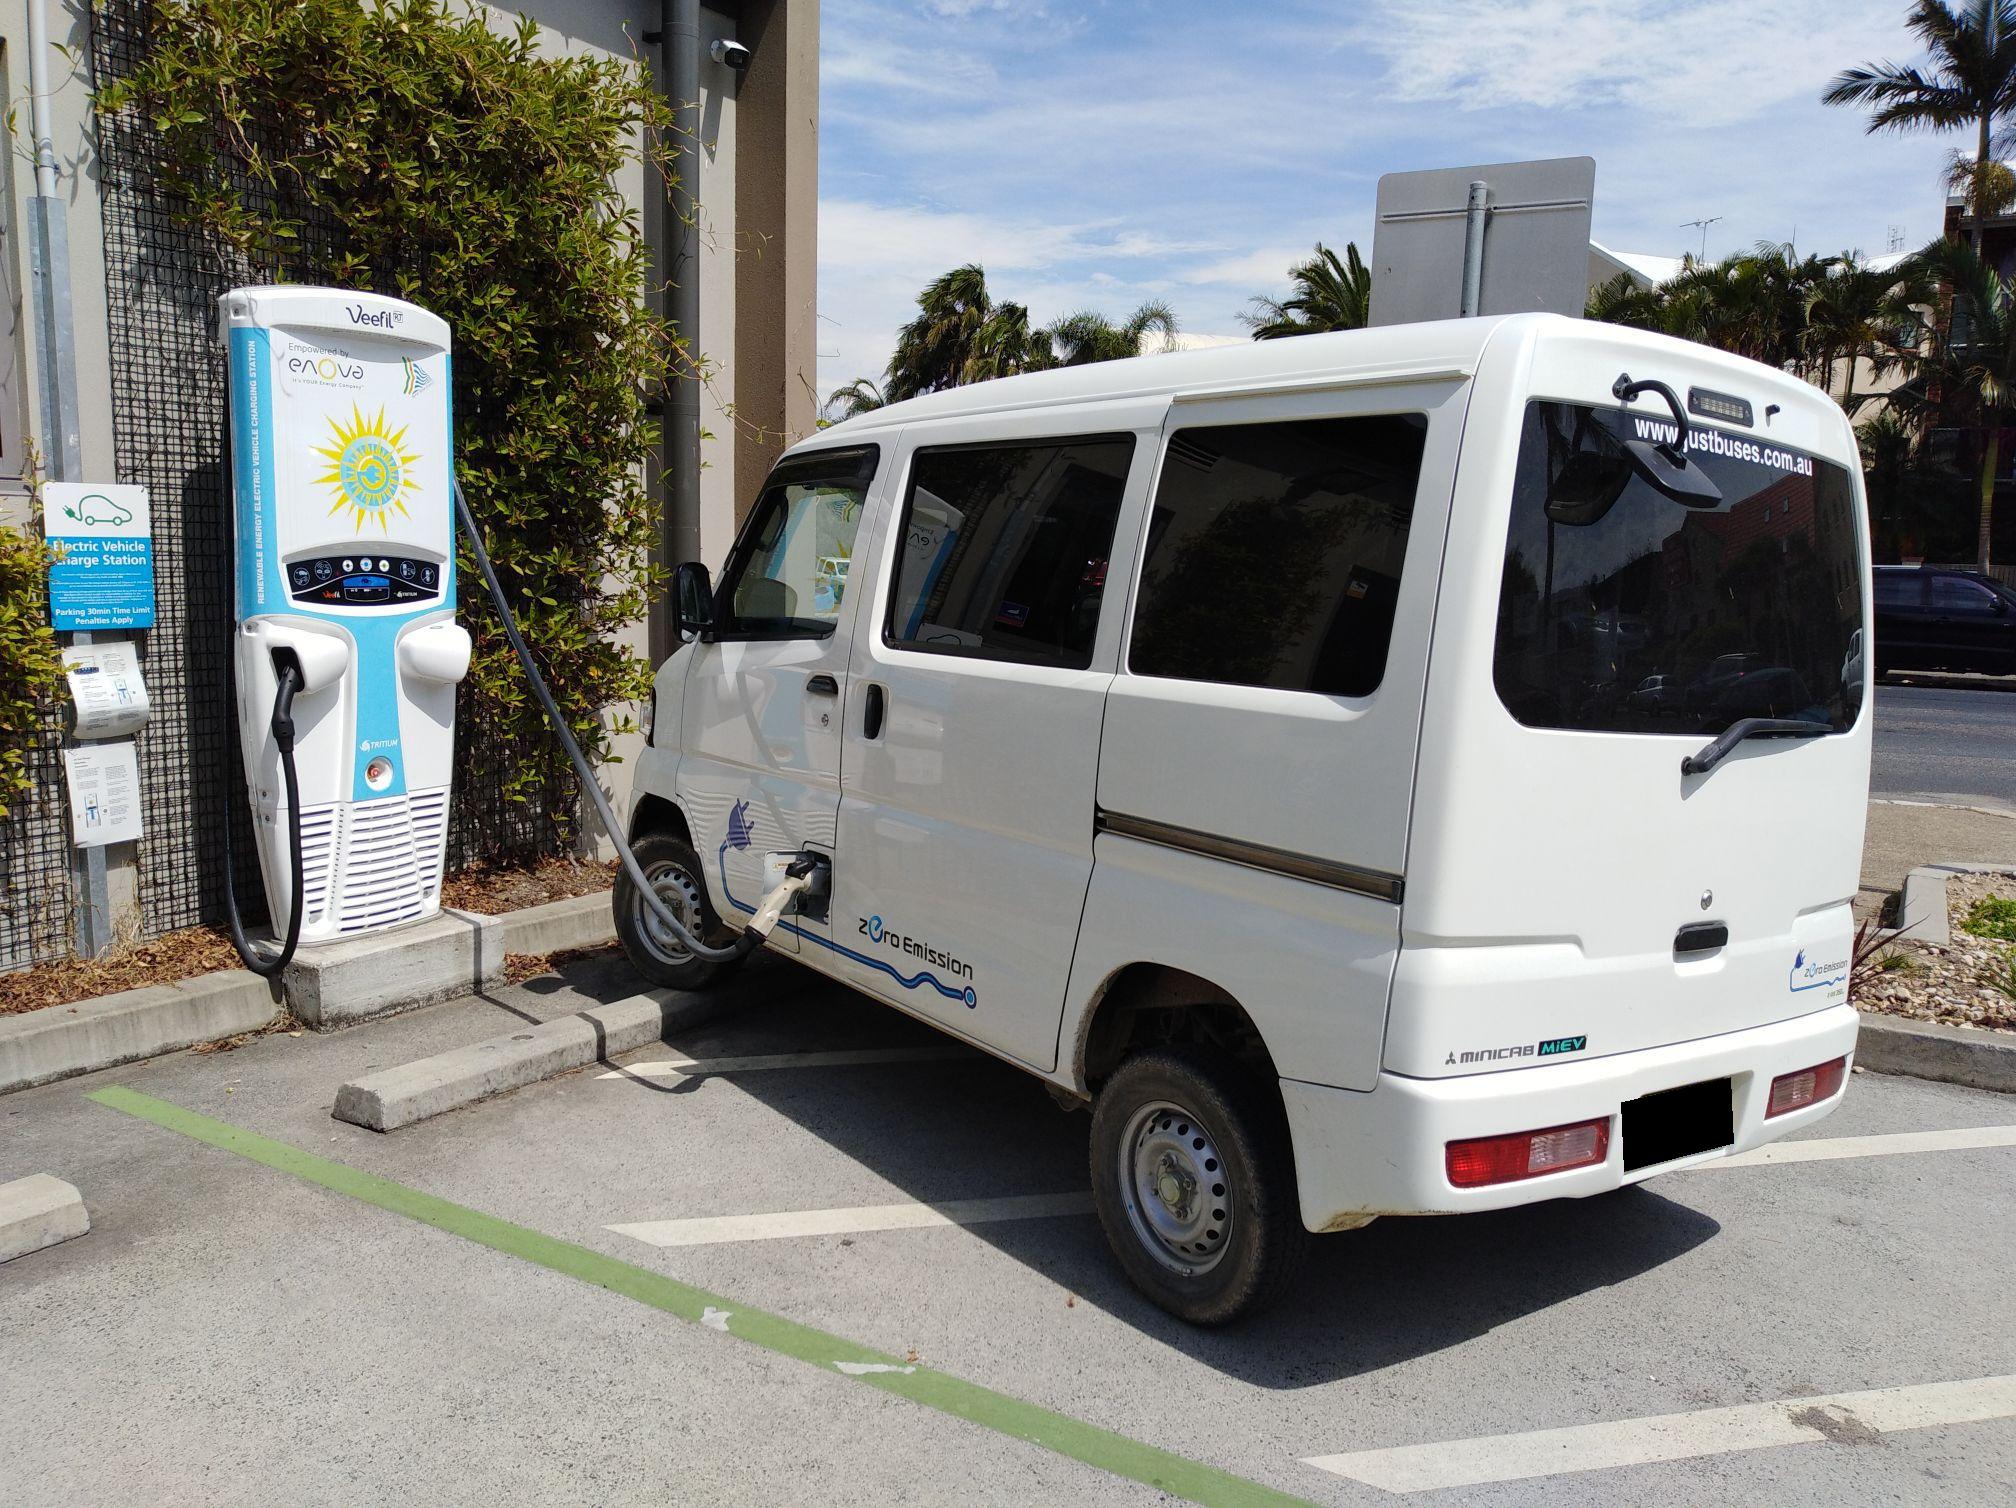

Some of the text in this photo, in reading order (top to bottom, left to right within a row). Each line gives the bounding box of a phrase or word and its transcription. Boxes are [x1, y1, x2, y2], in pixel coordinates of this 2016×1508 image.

[346, 305, 394, 328] Veefil
[288, 343, 349, 358] Empowered by
[251, 380, 259, 427] CHARGING
[252, 429, 260, 466] VEHICLE
[1634, 418, 1813, 477] wwwjustbuses.com.au
[253, 468, 262, 512] ELECTRIC
[255, 514, 263, 549] ENERGY
[102, 541, 146, 552] Vehicle
[56, 555, 147, 568] arge Station
[257, 551, 265, 604] RENEWABLE
[55, 608, 86, 617] Parking
[87, 607, 111, 615] 30min
[132, 606, 151, 614] Limit
[75, 616, 134, 625] Penalties Apply
[370, 739, 398, 749] TRITIUM
[903, 936, 973, 981] Emission
